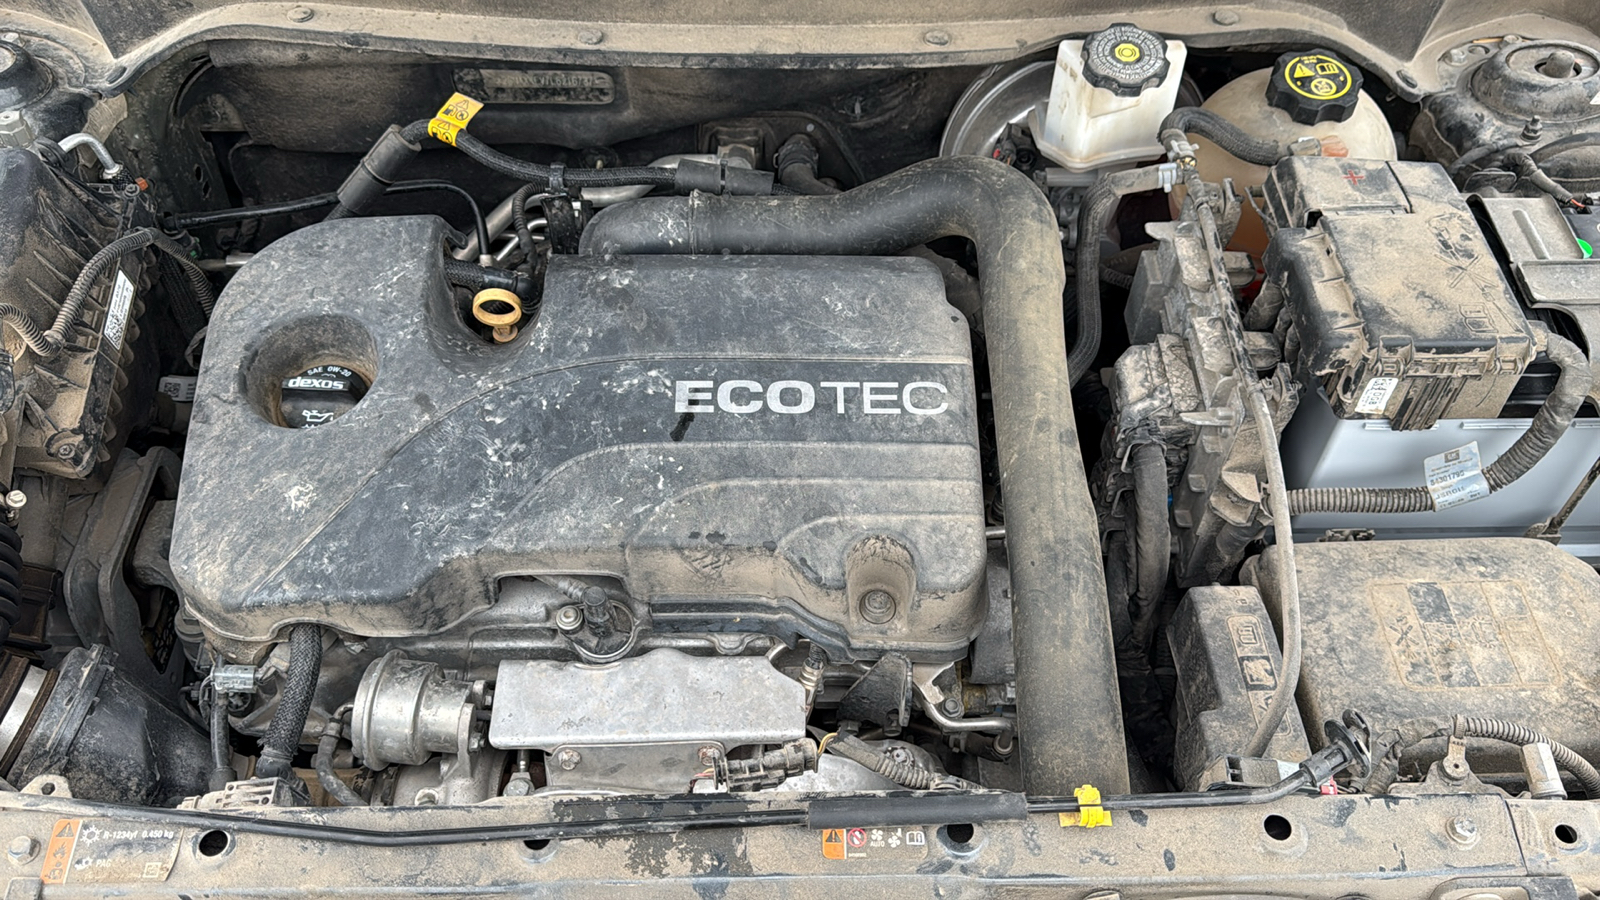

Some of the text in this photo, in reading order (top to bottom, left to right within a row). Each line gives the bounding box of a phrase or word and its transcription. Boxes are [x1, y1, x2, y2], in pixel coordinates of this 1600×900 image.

[307, 366, 352, 377] SAE 0W-20
[288, 376, 344, 390] dexos
[674, 380, 949, 414] ECOTEC
[102, 830, 174, 840] R-1234yf 0.450 kg
[96, 859, 112, 868] PAG
